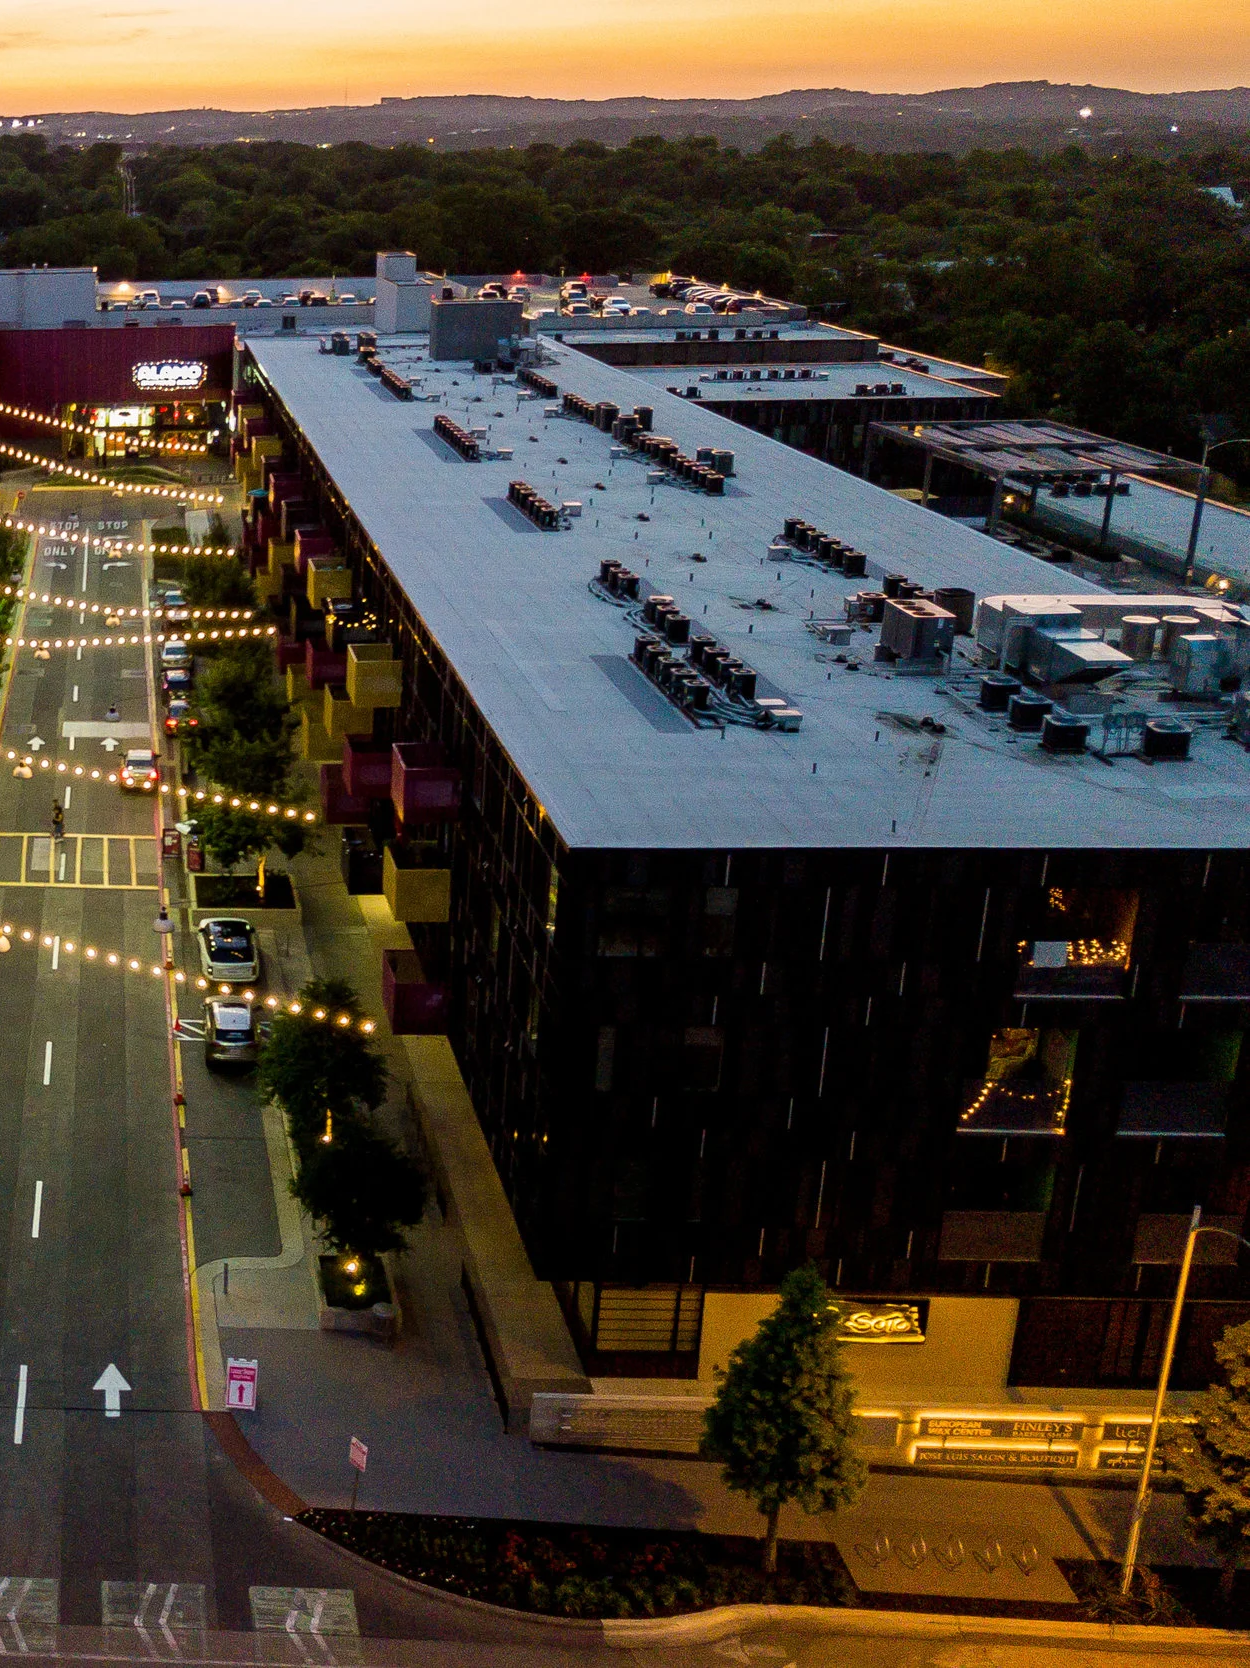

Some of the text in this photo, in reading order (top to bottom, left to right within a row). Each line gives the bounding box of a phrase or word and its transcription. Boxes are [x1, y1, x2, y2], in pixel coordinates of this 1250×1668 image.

[137, 365, 202, 380] ALAMO
[50, 521, 79, 530] STOP
[97, 521, 128, 530] STOP
[44, 546, 77, 556] ONLY
[928, 1420, 982, 1429] EUROPEAN
[1013, 1422, 1073, 1432] FINLEY'S
[952, 1428, 992, 1436] CENTER
[971, 1453, 1005, 1462] SALON
[1008, 1454, 1018, 1462] &
